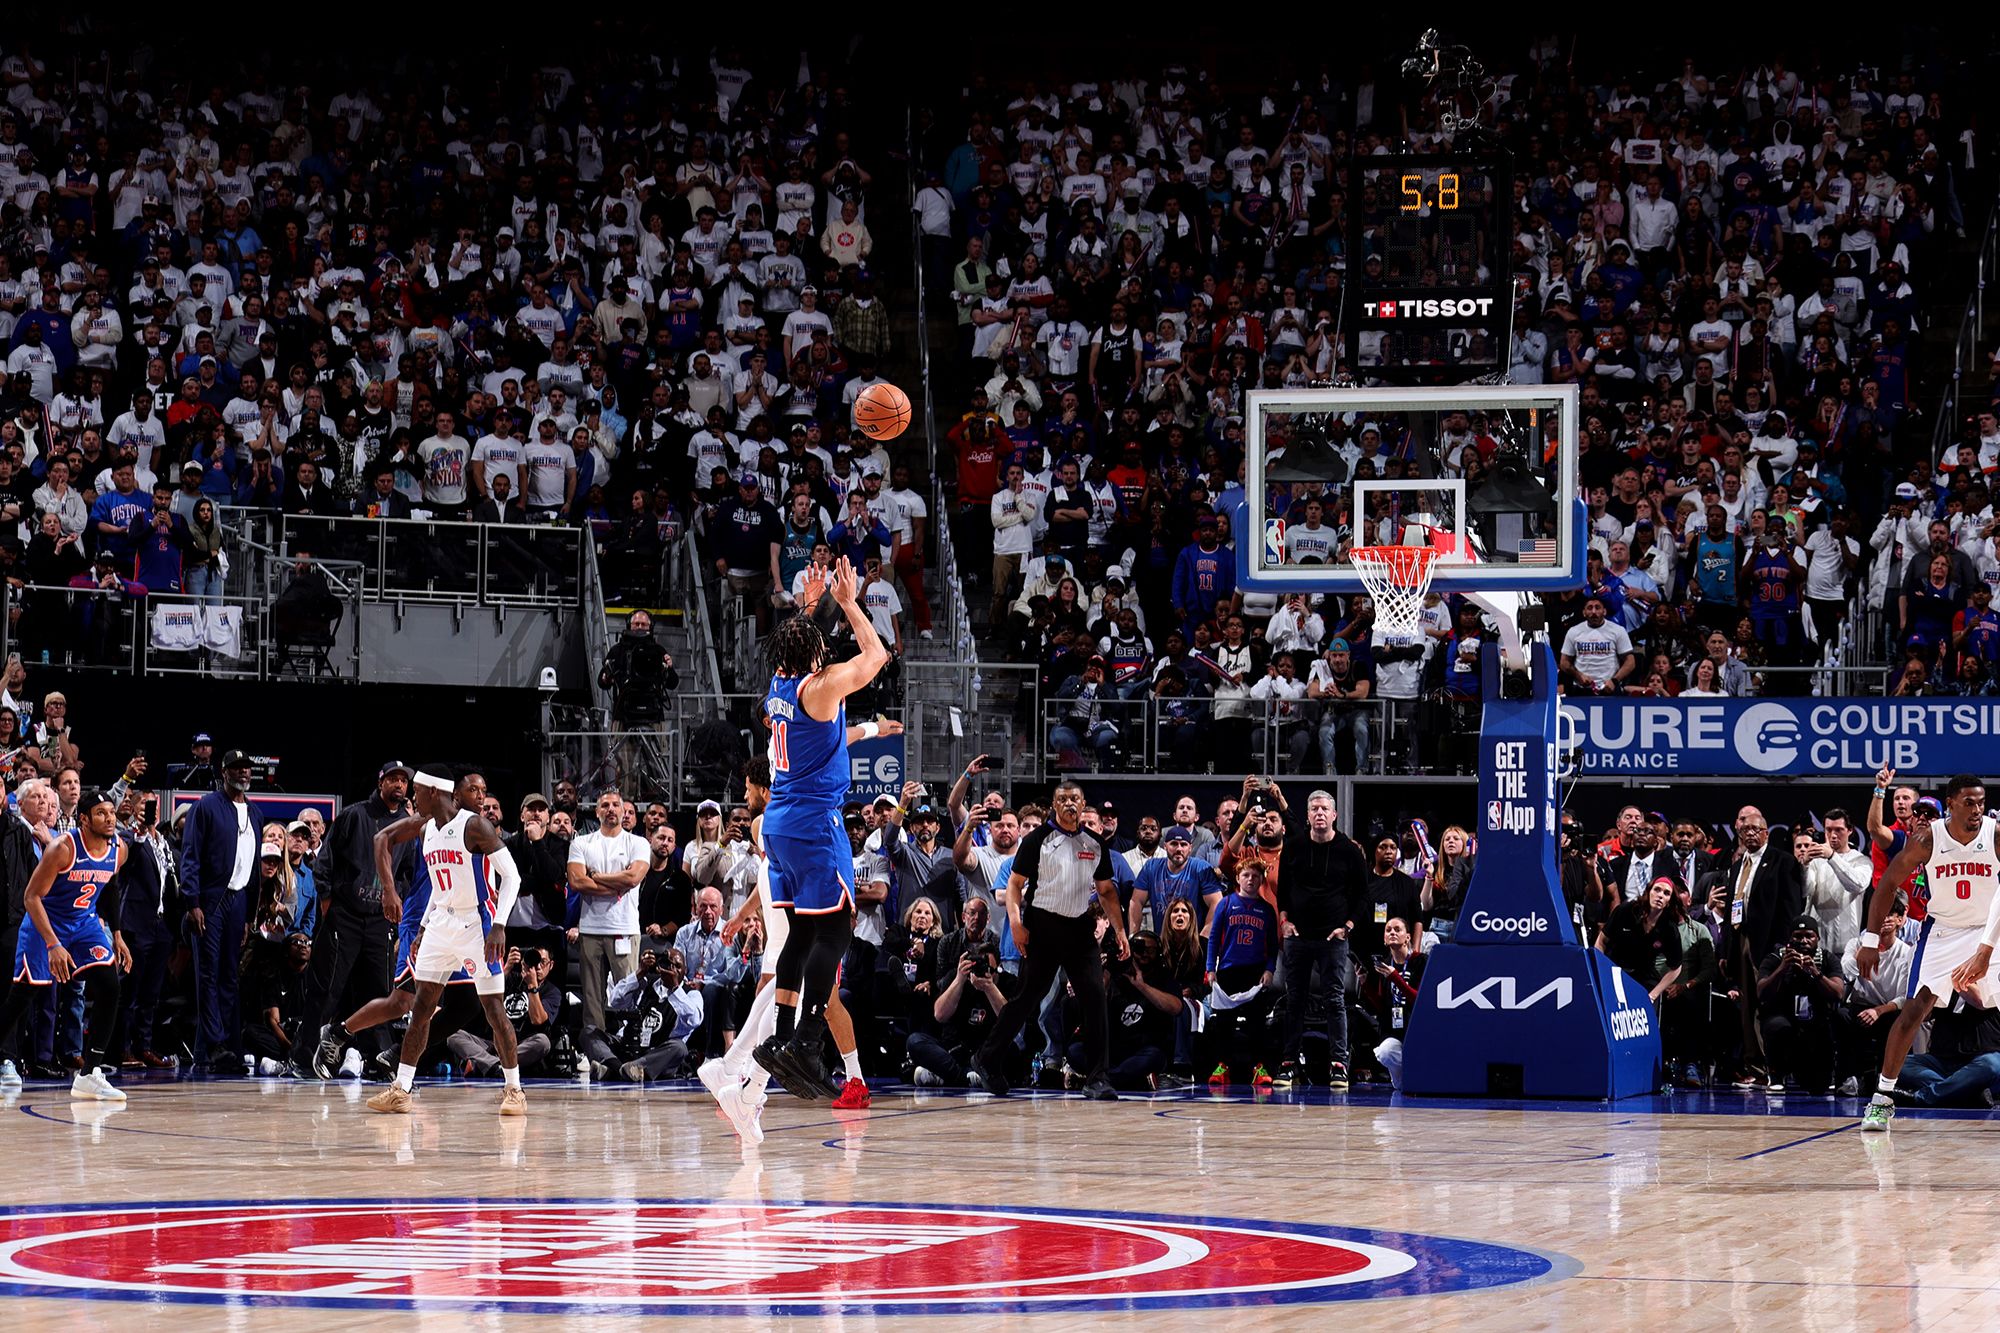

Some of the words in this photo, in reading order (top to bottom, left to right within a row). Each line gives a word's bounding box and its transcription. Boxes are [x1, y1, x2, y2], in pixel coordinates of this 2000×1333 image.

[1401, 174, 1459, 210] 5.8
[768, 264, 793, 274] MICHIGAN
[1398, 298, 1494, 318] TISSOT
[239, 325, 259, 335] PISTO
[532, 456, 561, 466] DEEETROIT
[158, 538, 168, 552] 2
[1296, 538, 1328, 550] DEEETROIT
[1199, 573, 1213, 590] 11
[1718, 569, 1727, 581] 2
[1759, 582, 1786, 602] 30
[1115, 646, 1143, 657] DET
[1576, 641, 1611, 652] DEEETROIT
[767, 698, 794, 722] BRUNSON
[771, 719, 790, 772] 11
[1810, 739, 1920, 770] CLUB
[1494, 741, 1527, 770] GET
[1495, 771, 1527, 799] THE
[1503, 804, 1535, 836] App
[425, 849, 464, 866] PISTONS
[67, 870, 90, 883] NEW
[435, 868, 453, 891] 17
[1935, 862, 1992, 879] PISTONS
[73, 884, 97, 909] 2
[357, 887, 382, 901] PAR
[1956, 880, 1971, 900] 0
[1471, 911, 1548, 937] Google
[1236, 929, 1254, 945] 12
[1610, 1007, 1649, 1042] coinbase
